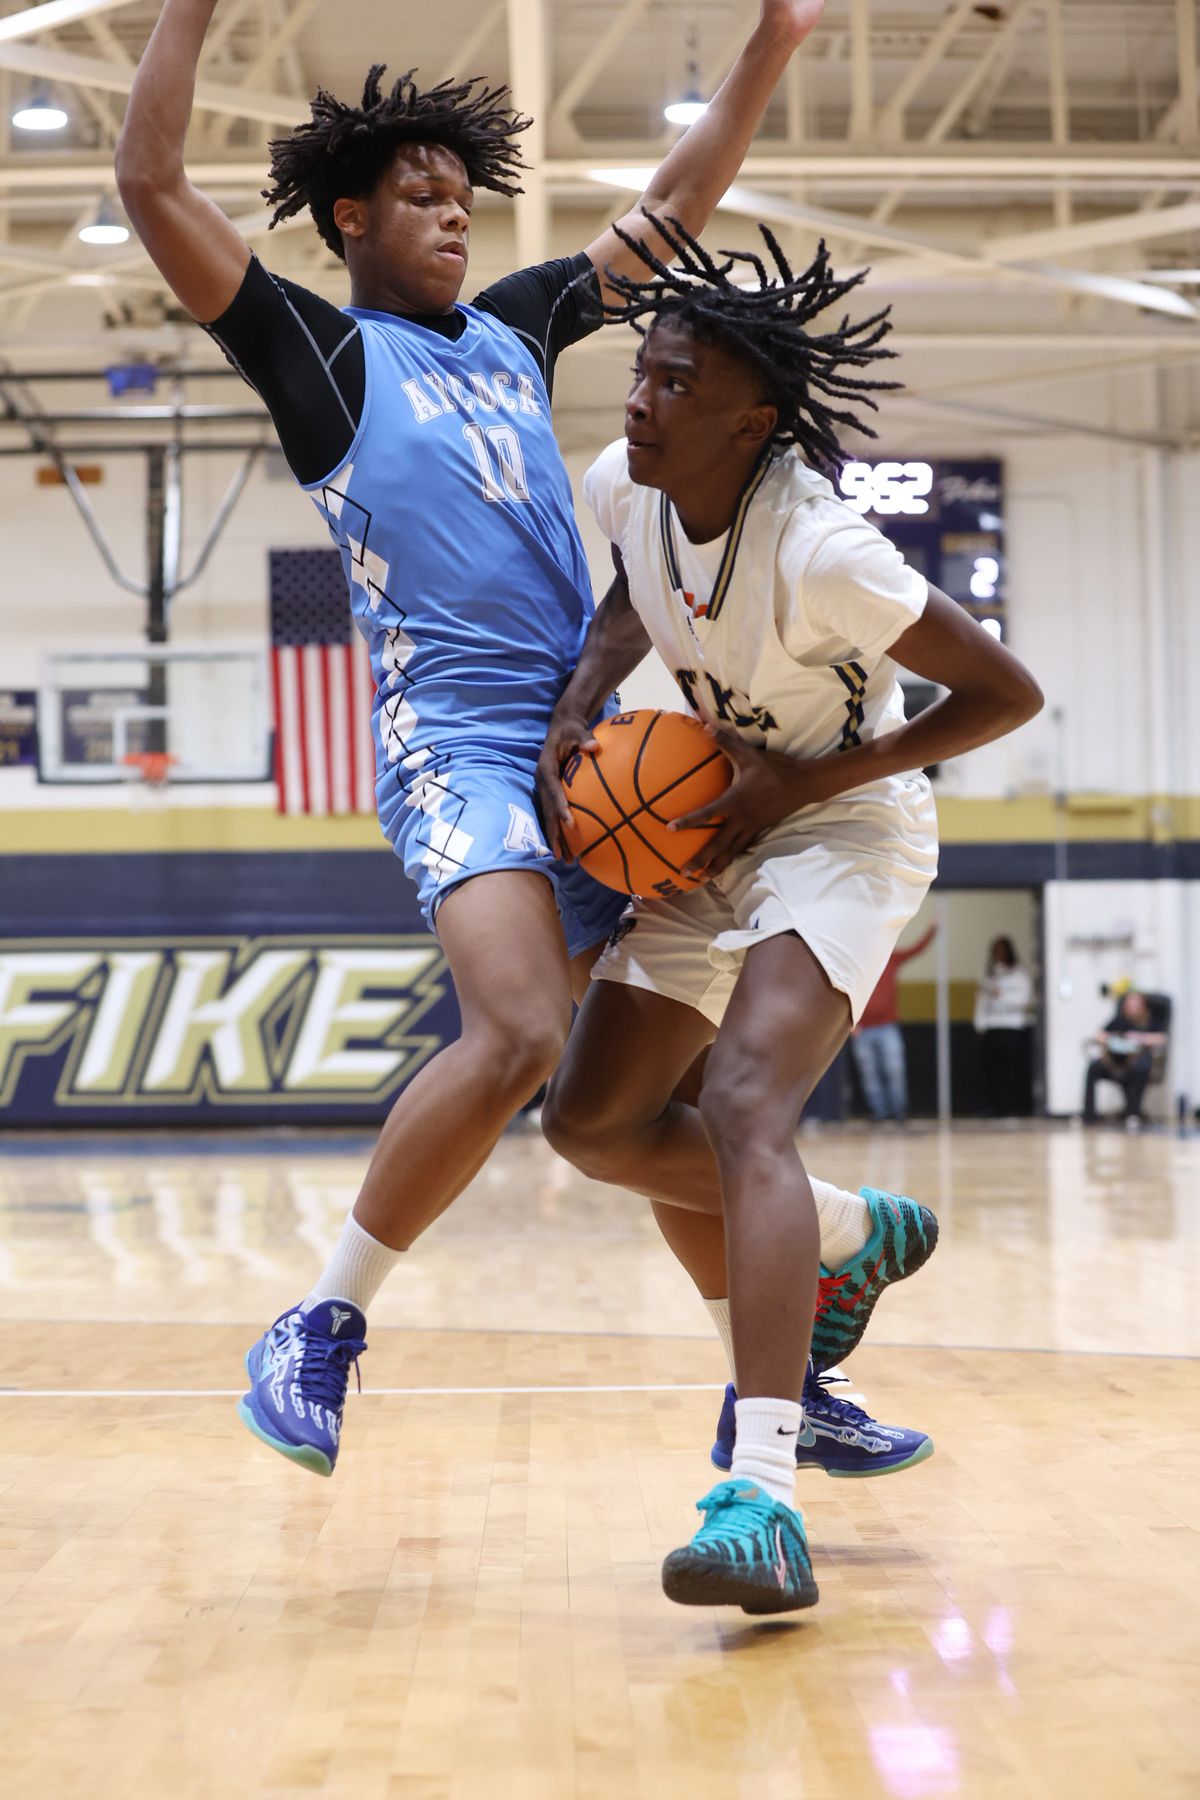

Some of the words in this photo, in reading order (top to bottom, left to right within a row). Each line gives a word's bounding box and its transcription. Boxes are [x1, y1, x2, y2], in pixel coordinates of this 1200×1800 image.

[462, 421, 532, 503] 10
[503, 803, 550, 857] A
[0, 944, 447, 1100] FIKE
